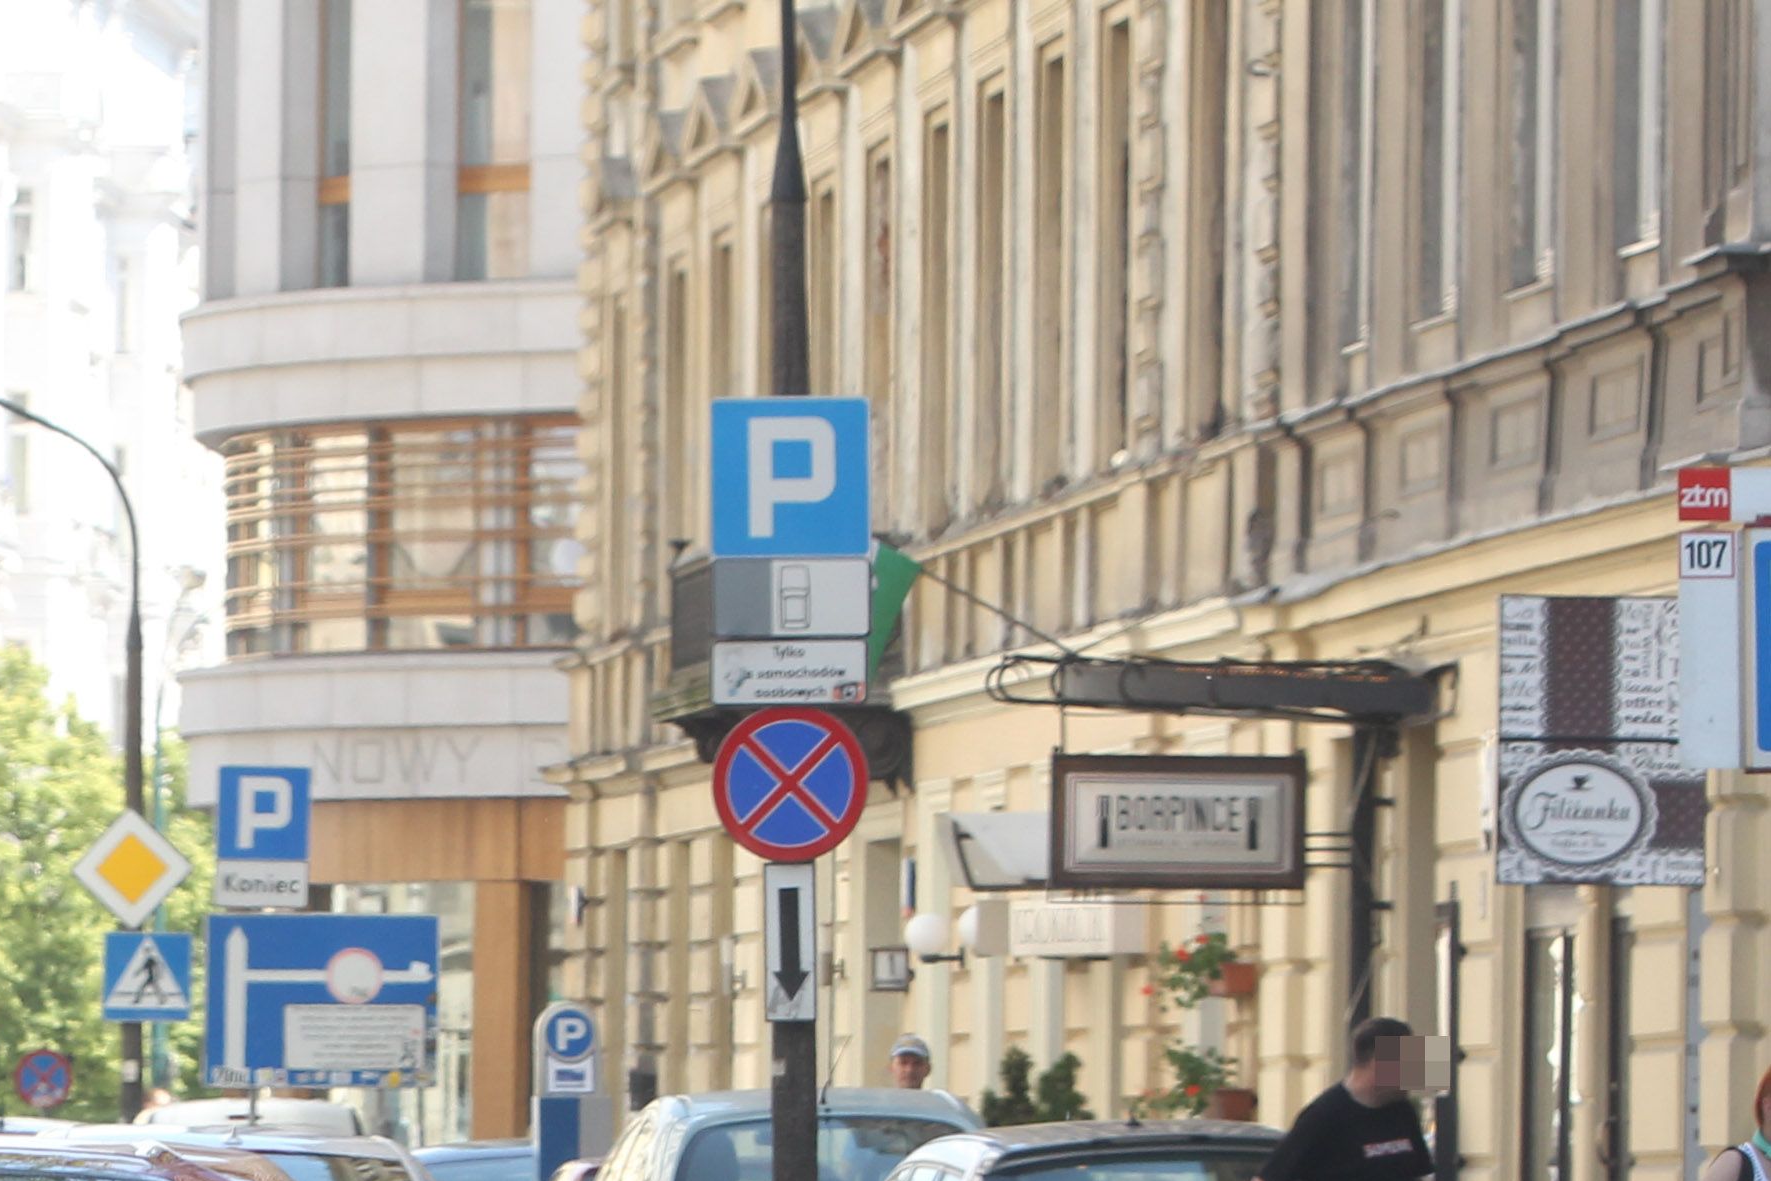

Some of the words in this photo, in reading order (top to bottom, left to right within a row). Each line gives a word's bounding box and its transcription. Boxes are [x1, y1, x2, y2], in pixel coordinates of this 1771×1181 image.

[747, 416, 836, 538] P
[1680, 484, 1729, 508] ztm
[1684, 540, 1727, 569] 107
[313, 736, 483, 784] NOWY
[236, 776, 293, 849] P
[1116, 795, 1243, 832] BORPINCE
[224, 874, 301, 895] Koniec
[555, 1017, 587, 1051] P
